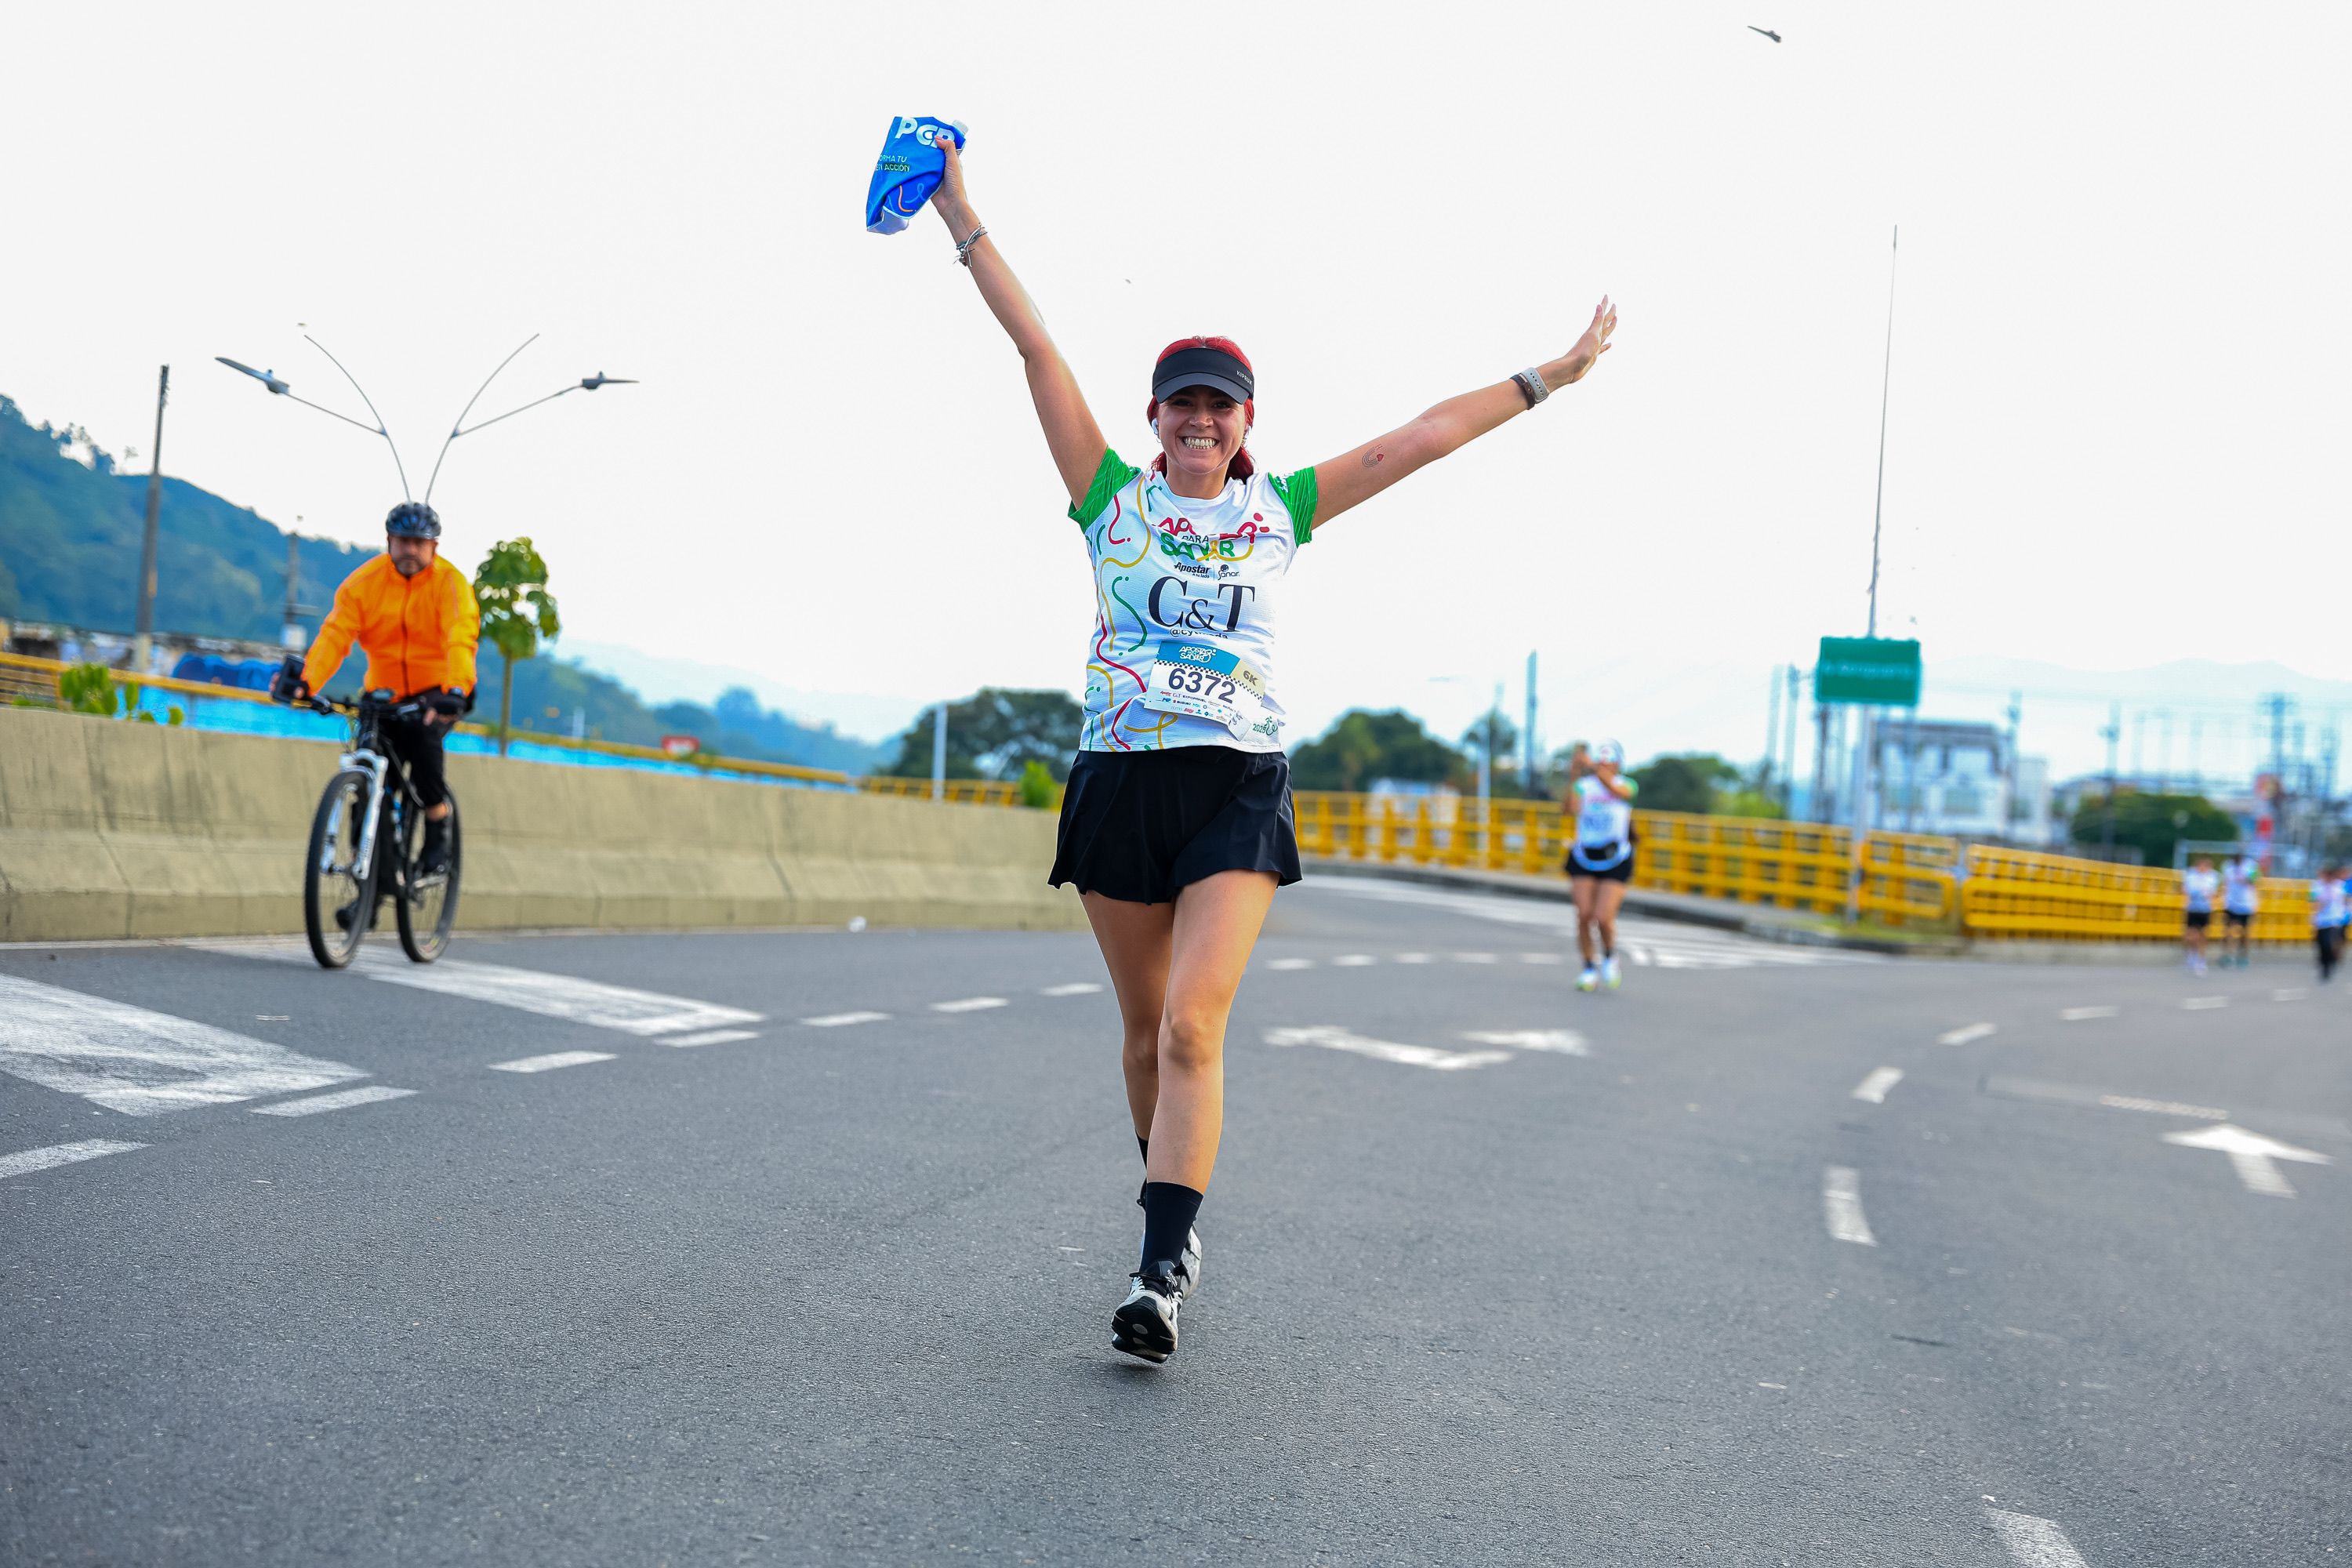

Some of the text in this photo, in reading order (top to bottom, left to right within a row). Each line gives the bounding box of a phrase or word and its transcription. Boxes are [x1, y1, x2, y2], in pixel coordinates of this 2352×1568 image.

[884, 163, 910, 172] ACCIÓN
[1174, 561, 1210, 574] Apostar
[1148, 575, 1256, 633] C&T
[1168, 668, 1236, 704] 6372
[1243, 670, 1259, 686] 6K
